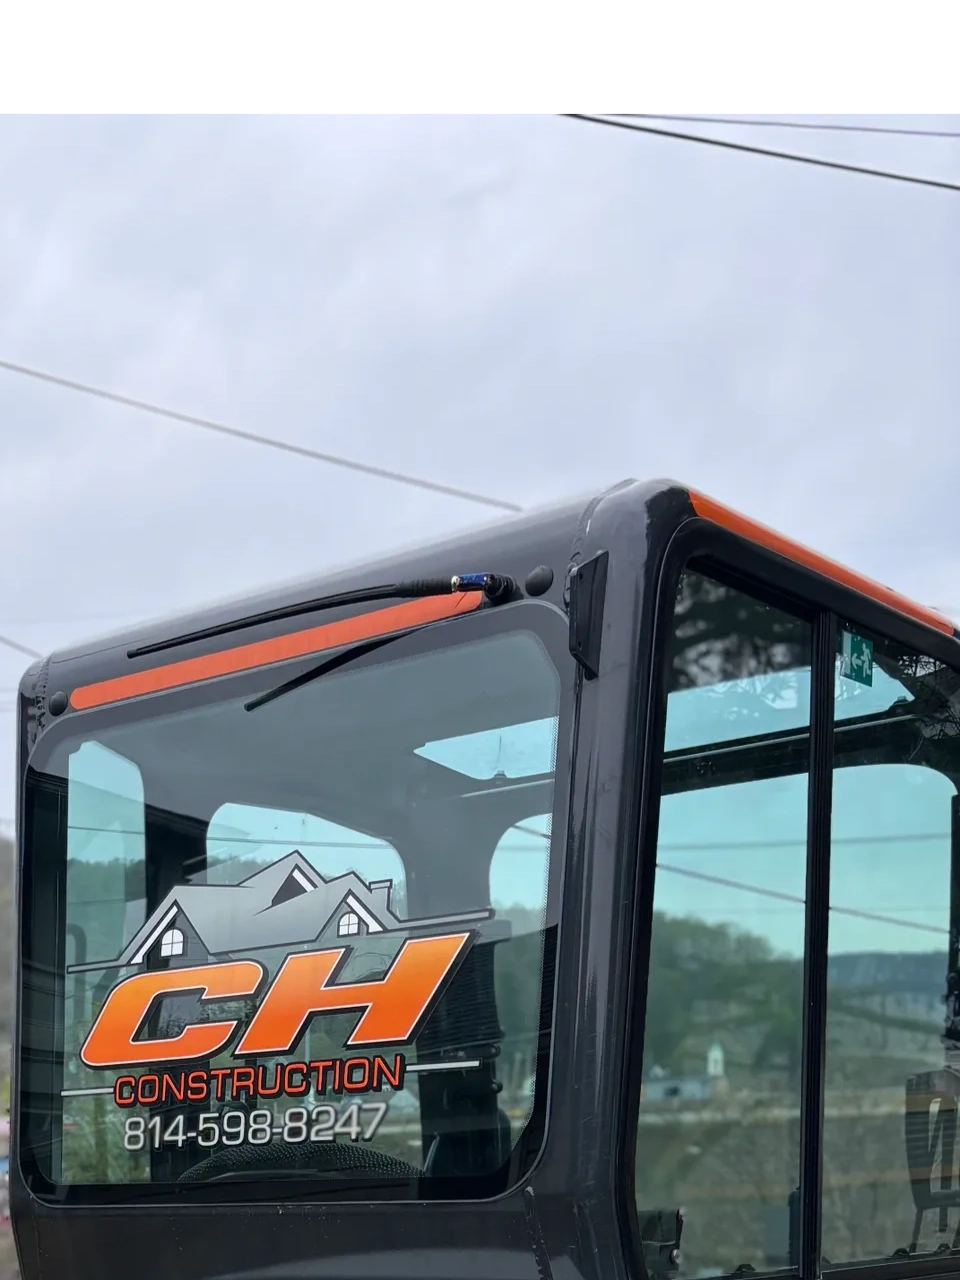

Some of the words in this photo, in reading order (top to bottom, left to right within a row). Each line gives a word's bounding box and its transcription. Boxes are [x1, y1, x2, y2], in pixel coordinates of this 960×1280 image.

[79, 930, 478, 1068] CH
[113, 1054, 405, 1108] CONSTRUCTION
[123, 1102, 389, 1152] 814-598-8247
